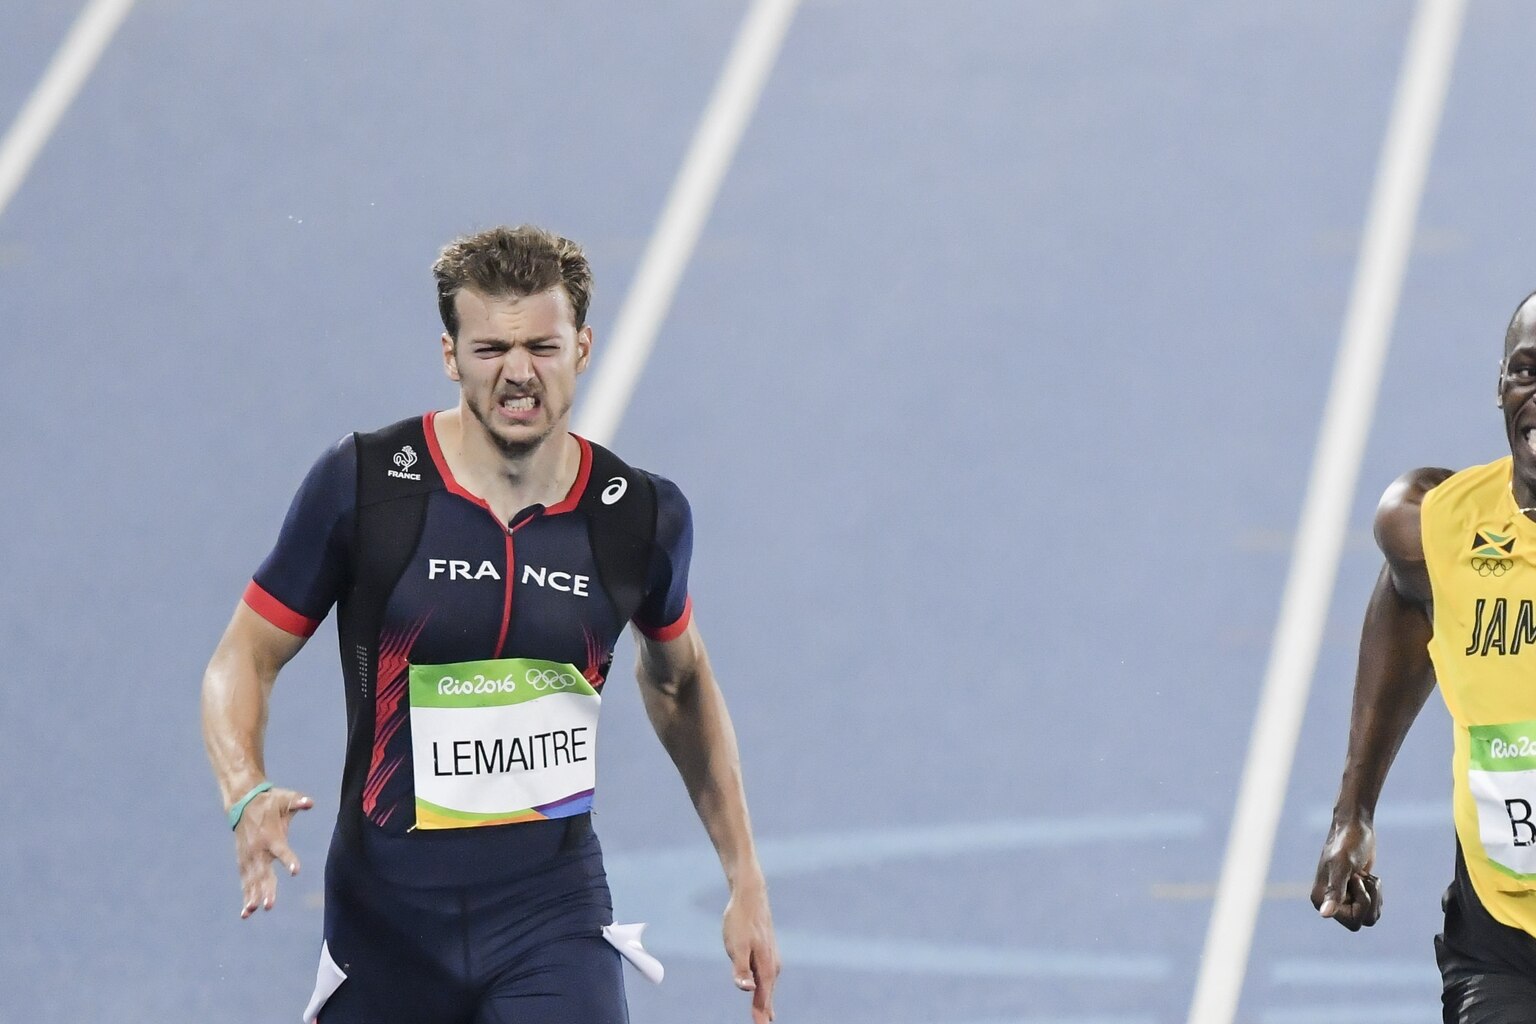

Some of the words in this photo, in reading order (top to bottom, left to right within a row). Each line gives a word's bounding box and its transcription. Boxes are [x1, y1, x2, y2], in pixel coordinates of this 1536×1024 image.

[387, 470, 421, 481] FRANCE
[428, 559, 590, 597] FRANCE
[432, 727, 588, 777] LEMAITRE
